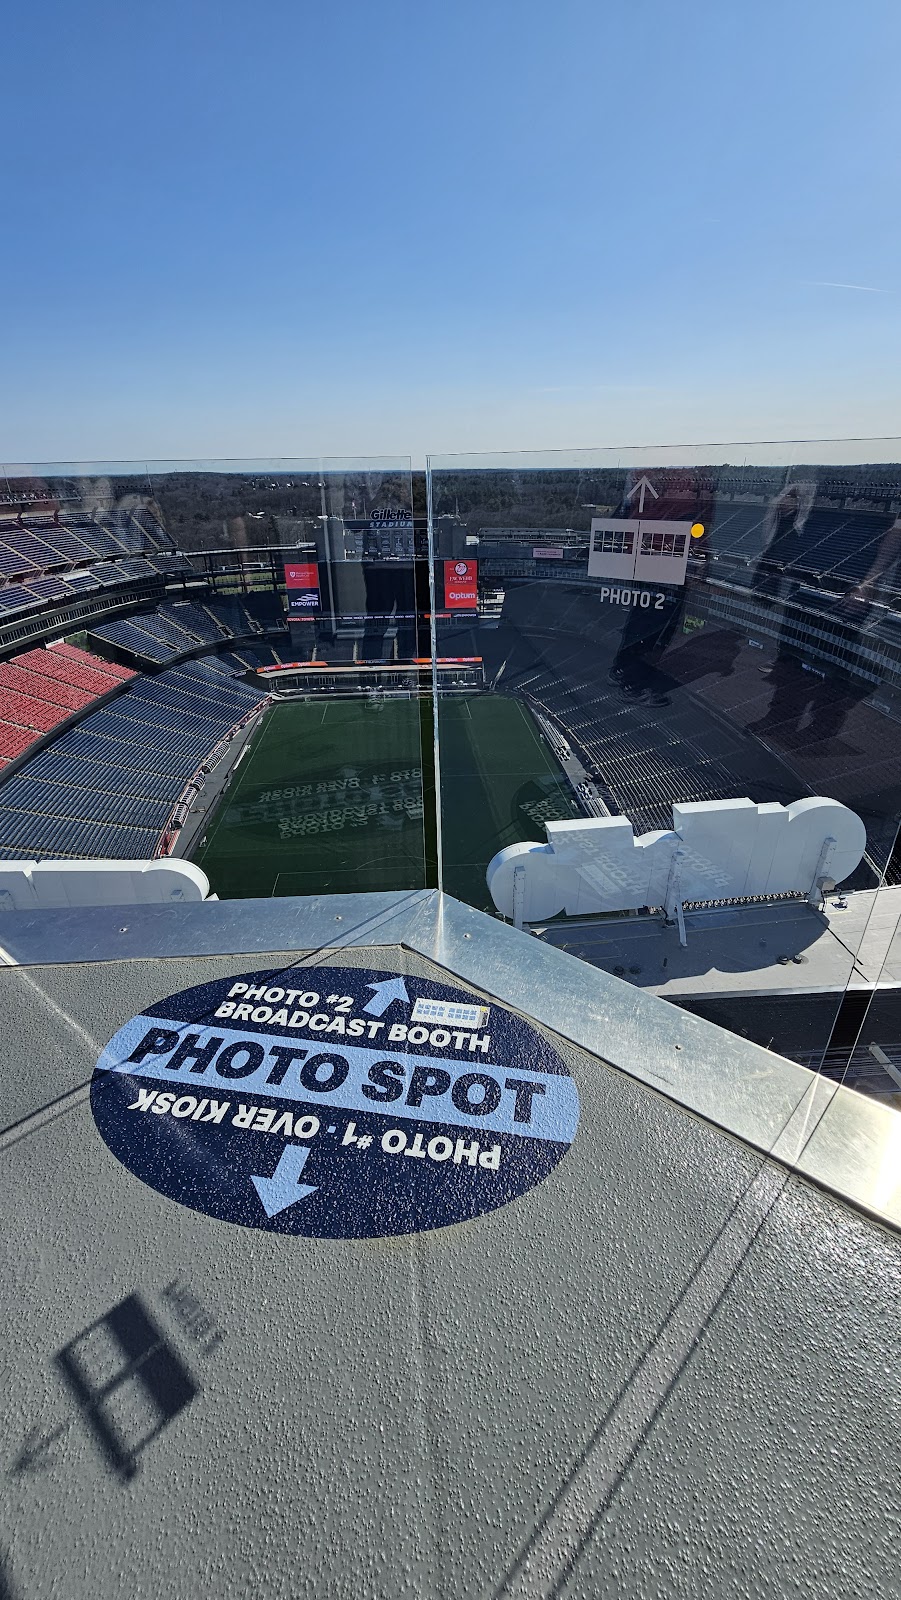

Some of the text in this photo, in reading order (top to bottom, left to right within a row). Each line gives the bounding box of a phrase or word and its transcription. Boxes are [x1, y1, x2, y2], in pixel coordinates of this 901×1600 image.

[370, 508, 412, 520] Gillette
[449, 592, 476, 600] Optum
[600, 587, 666, 610] PHOTO 2
[227, 982, 354, 1013] PHOTO #2
[214, 1001, 492, 1053] BROADCAST BOOTH
[127, 1027, 547, 1124] PHOTO SPOT
[127, 1088, 501, 1171] PHOTO #1 OVER KIOSK
